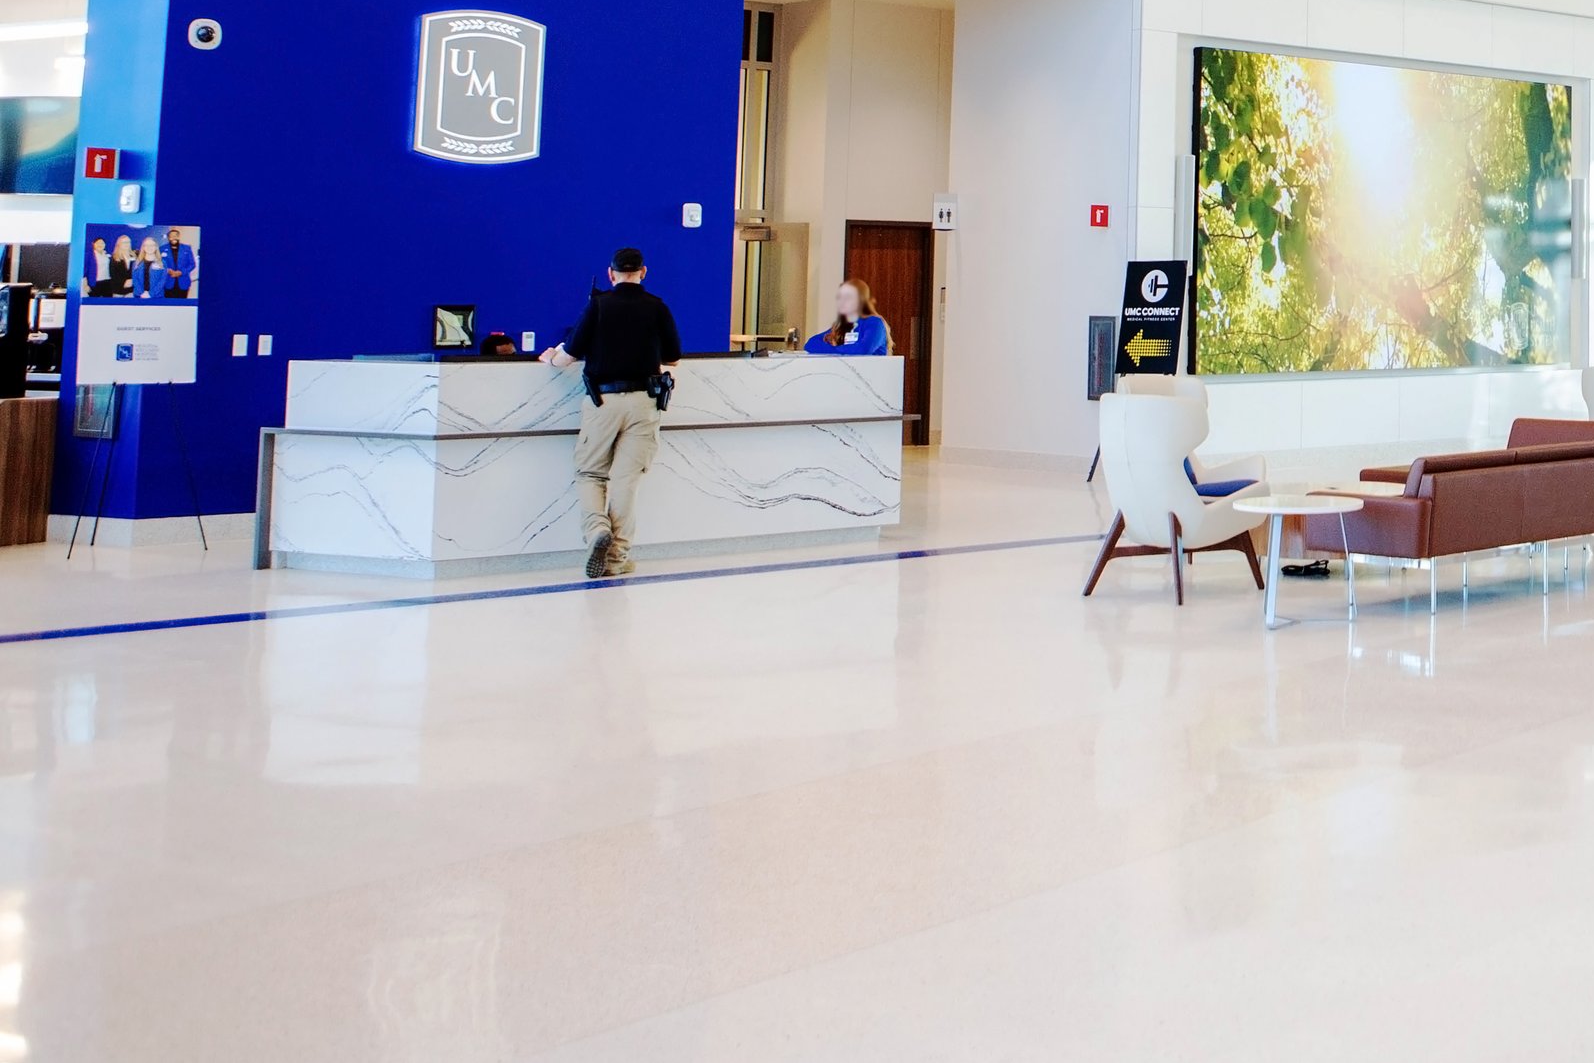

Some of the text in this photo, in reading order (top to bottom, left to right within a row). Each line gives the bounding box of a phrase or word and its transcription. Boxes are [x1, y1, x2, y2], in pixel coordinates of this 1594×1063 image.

[450, 48, 515, 125] UMC
[1124, 307, 1180, 316] UMC CONNECT
